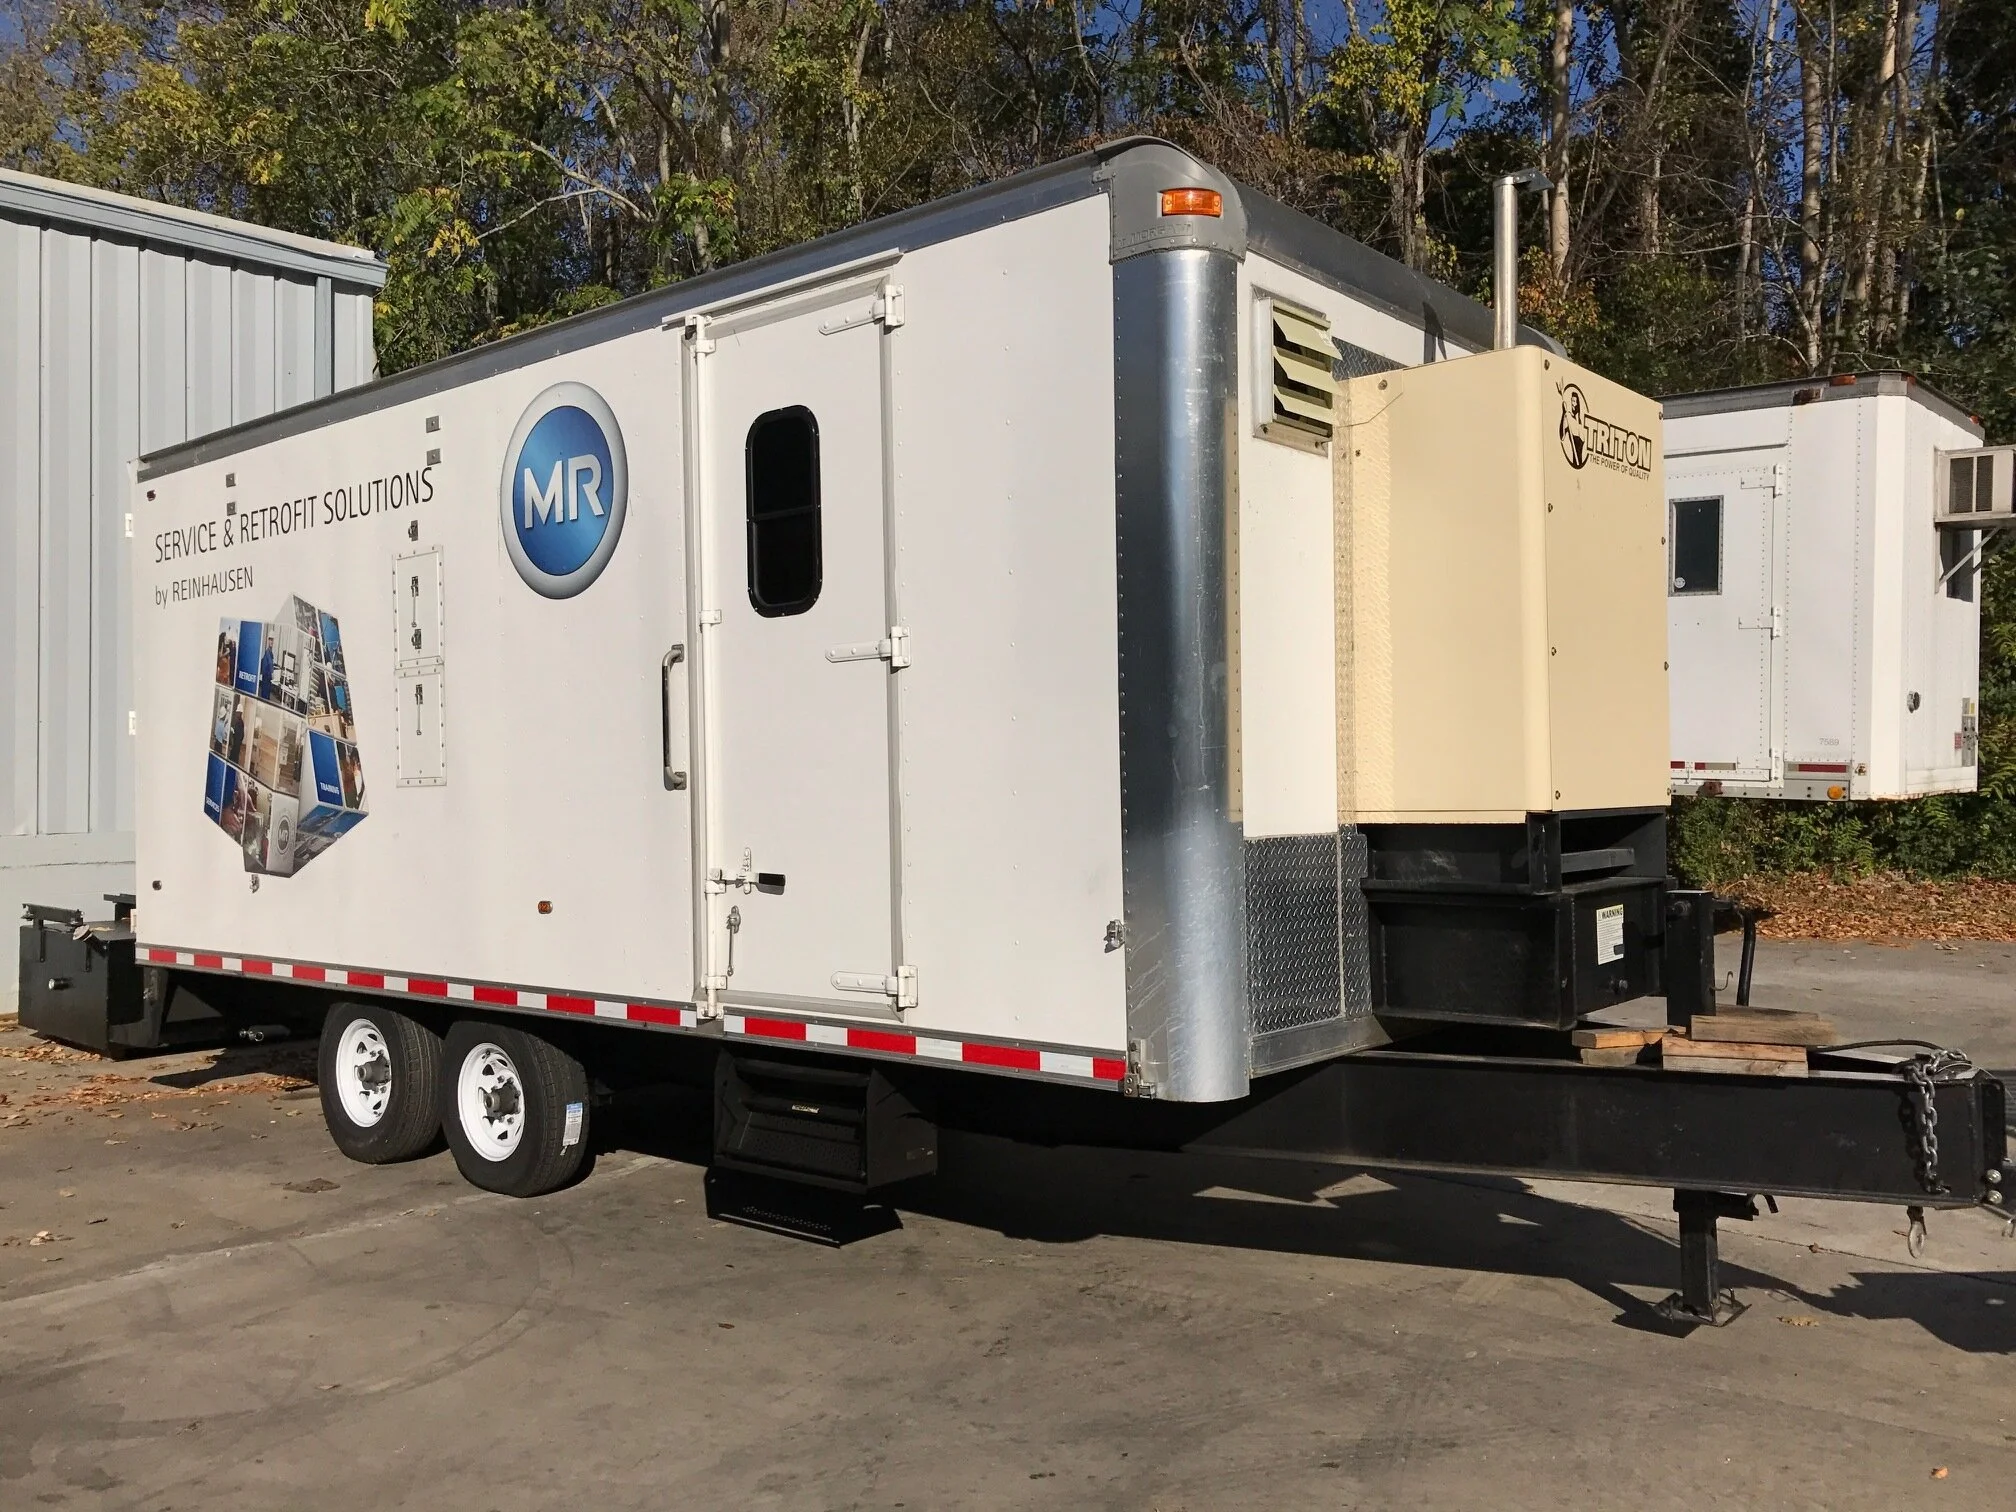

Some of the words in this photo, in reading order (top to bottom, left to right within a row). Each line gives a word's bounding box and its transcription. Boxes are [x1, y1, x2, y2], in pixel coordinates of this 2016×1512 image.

[1583, 413, 1652, 472] TRITON
[1589, 453, 1601, 466] THE
[1601, 457, 1620, 471] POWER
[1620, 464, 1629, 475] OF
[1629, 468, 1649, 481] QUALITY
[155, 520, 217, 563] SERVICE
[223, 518, 234, 548] &
[240, 495, 318, 544] RETROFIT
[323, 466, 434, 525] SOLUTIONS
[523, 452, 605, 530] MR
[155, 585, 168, 609] by
[172, 565, 254, 602] REINHAUSEN
